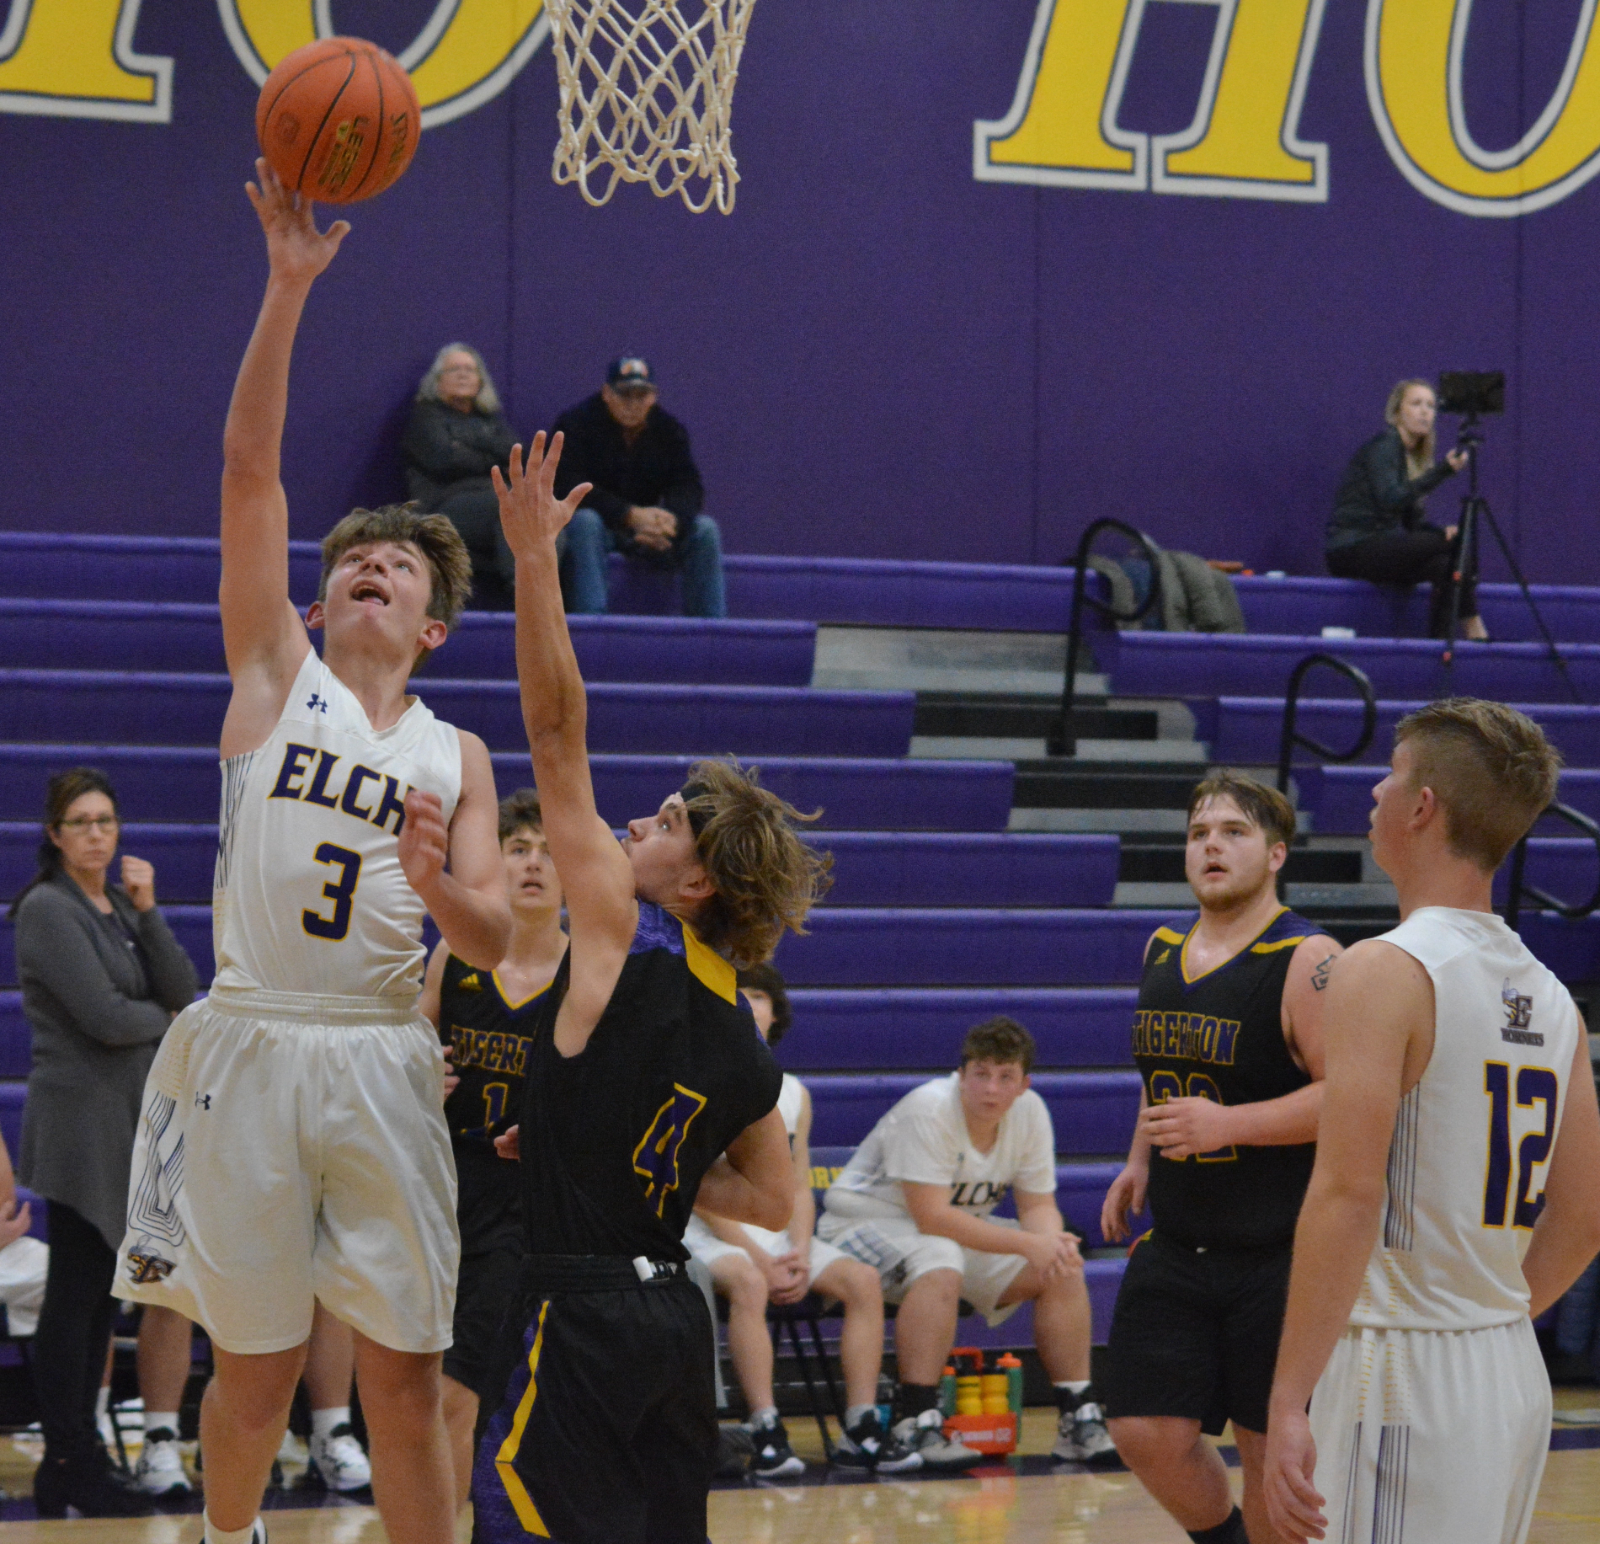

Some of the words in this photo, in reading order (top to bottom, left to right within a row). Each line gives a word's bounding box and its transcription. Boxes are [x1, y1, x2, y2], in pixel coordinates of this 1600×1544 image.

[302, 841, 363, 943] 3
[1131, 1010, 1242, 1066] TIGERTON
[632, 1081, 708, 1220] 4
[1481, 1059, 1558, 1231] 12
